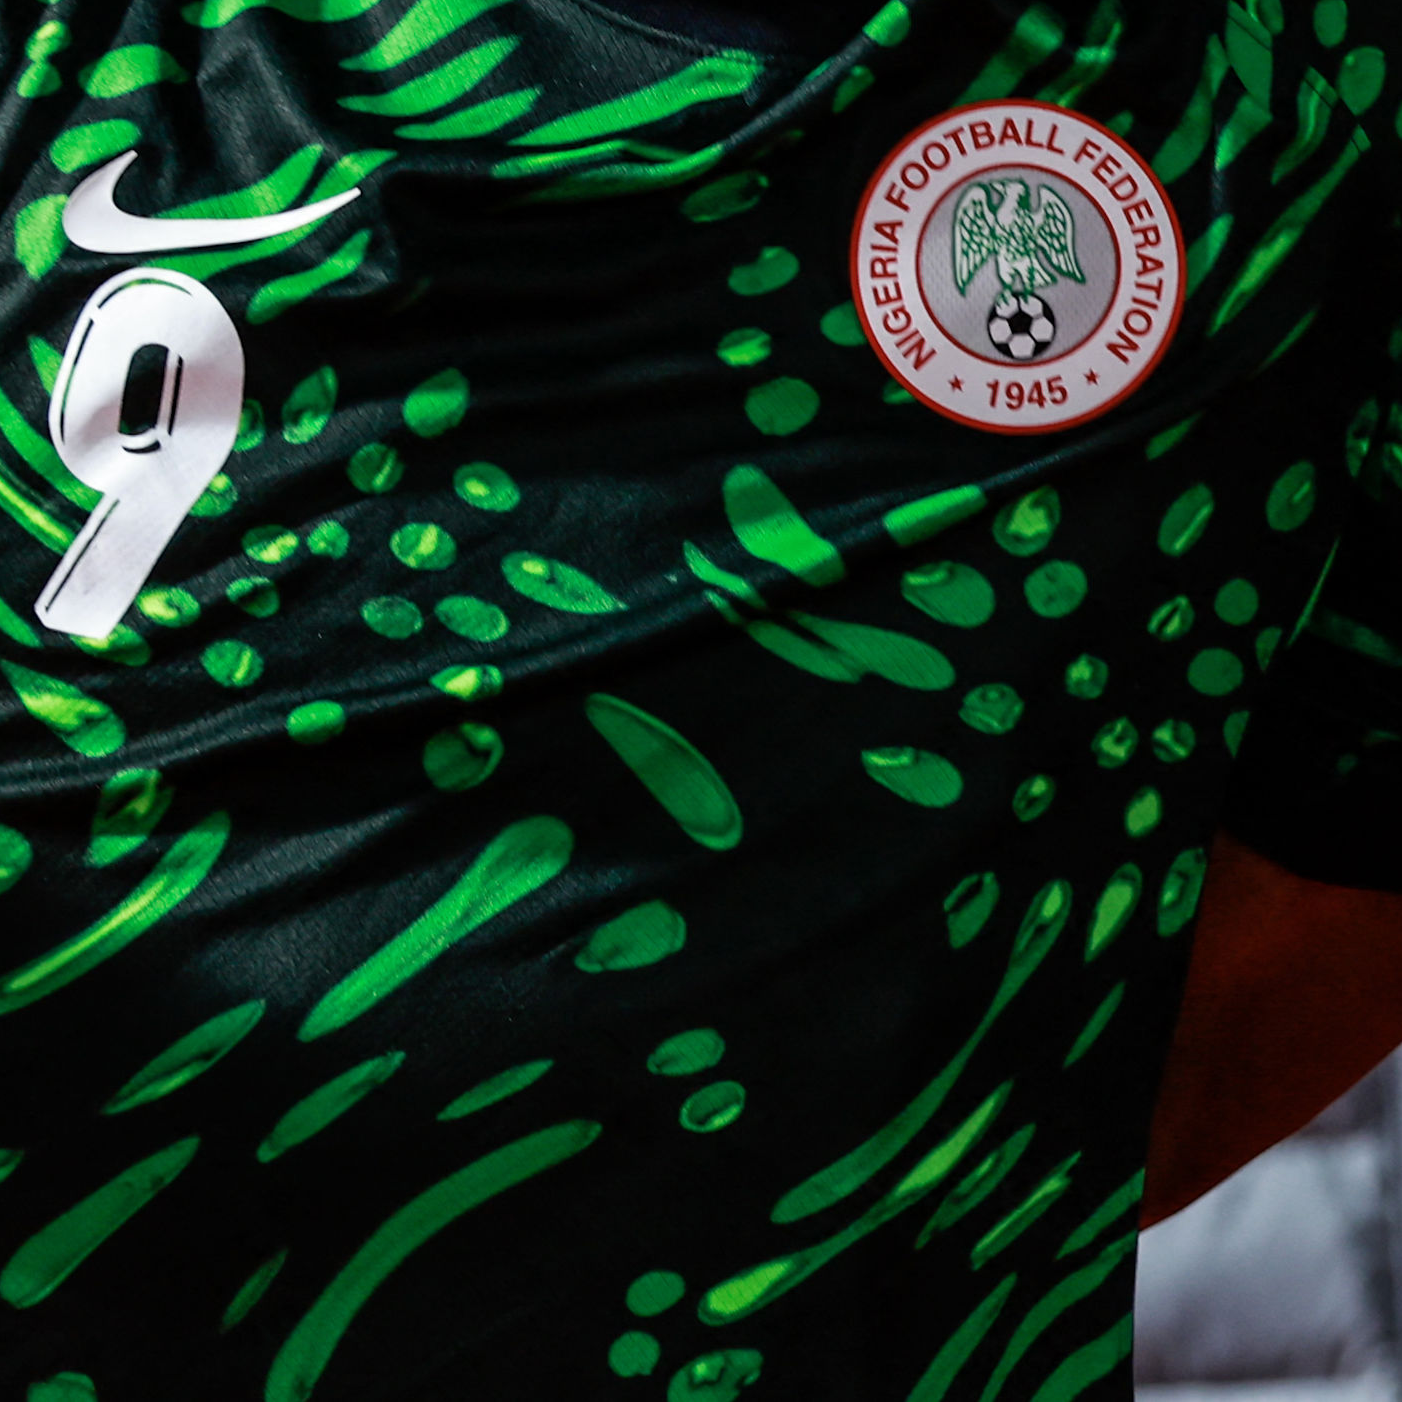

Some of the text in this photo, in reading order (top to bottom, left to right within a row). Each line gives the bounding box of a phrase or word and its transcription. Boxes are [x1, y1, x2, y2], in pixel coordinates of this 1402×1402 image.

[869, 116, 1165, 372] NIGERIA FOOTBALL FEDERATION
[34, 267, 246, 641] 9
[986, 375, 1070, 412] 1945
